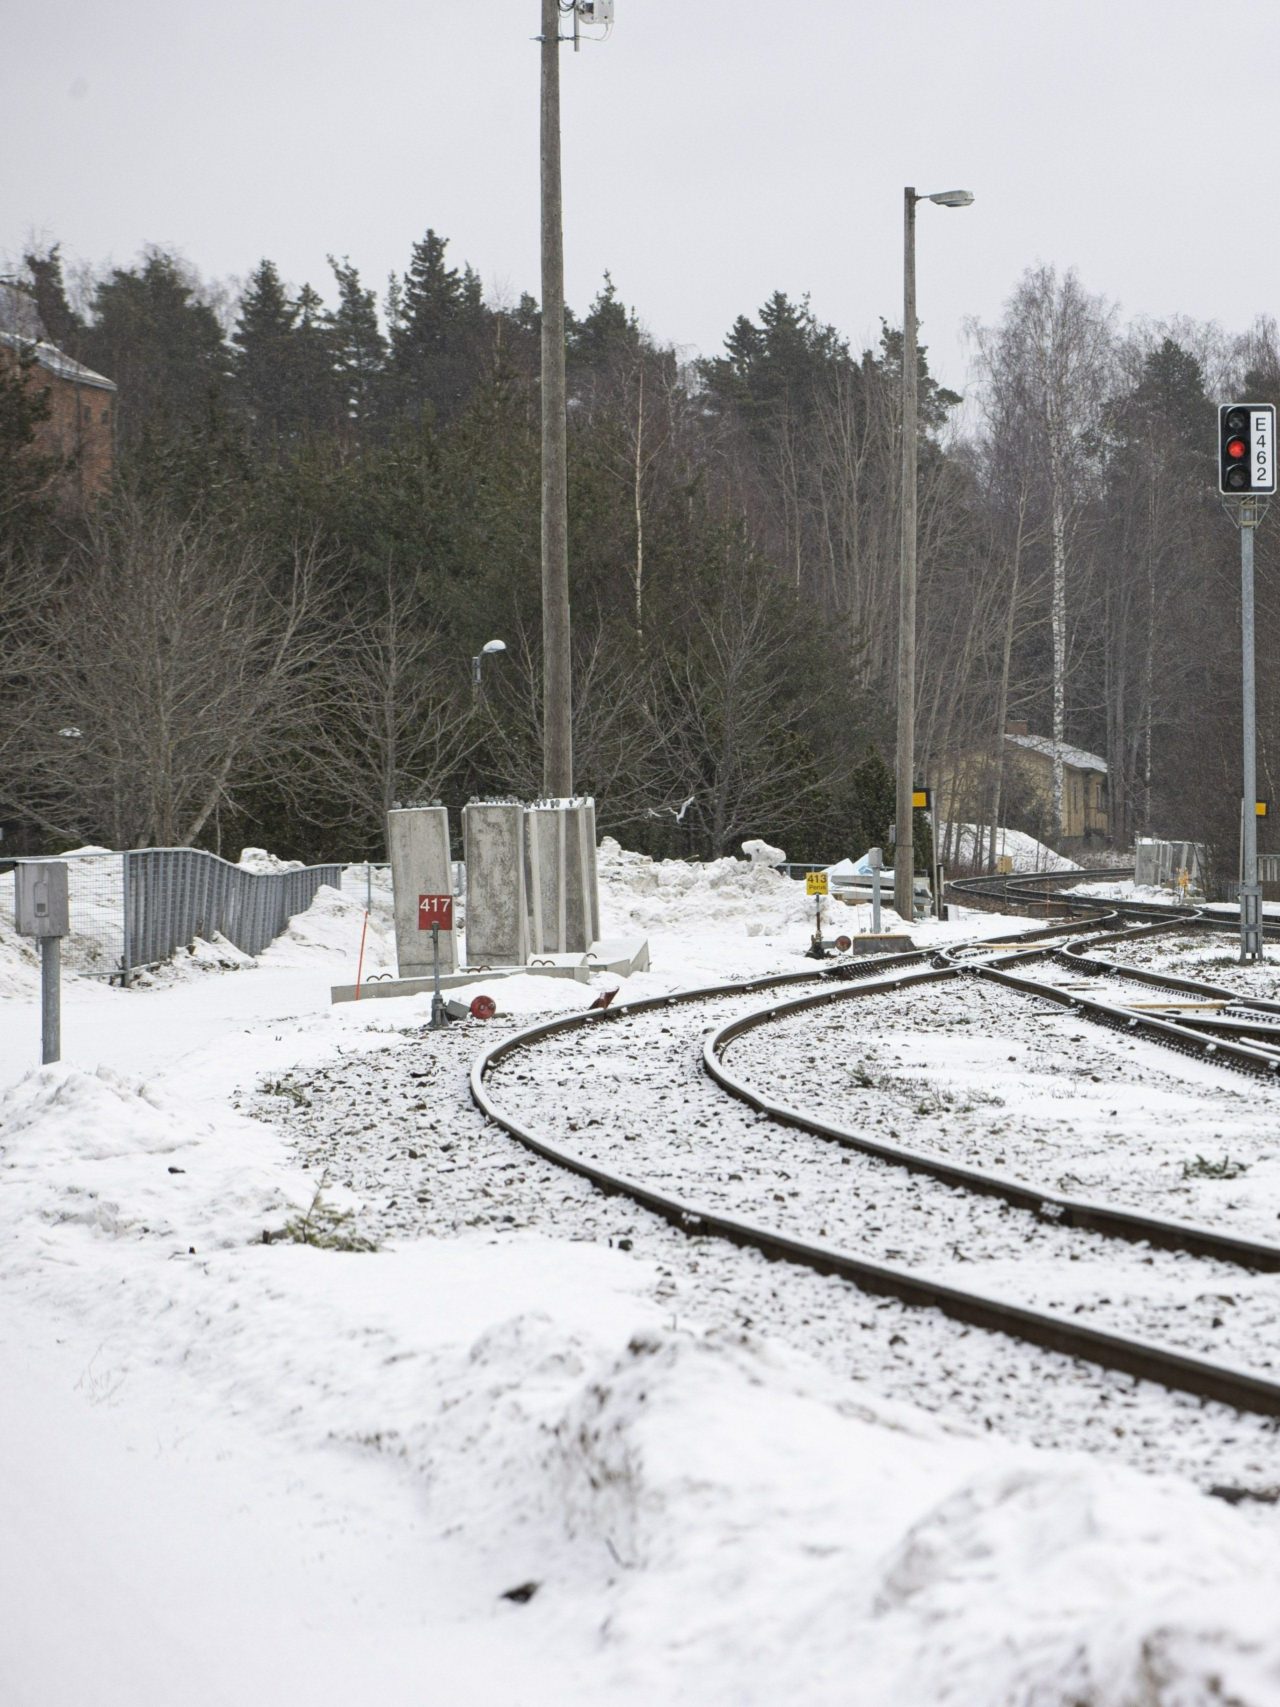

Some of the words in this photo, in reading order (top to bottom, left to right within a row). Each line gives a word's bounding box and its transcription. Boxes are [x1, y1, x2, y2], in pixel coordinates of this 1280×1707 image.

[1255, 417, 1267, 481] E462
[807, 874, 827, 883] 413
[420, 898, 451, 912] 417
